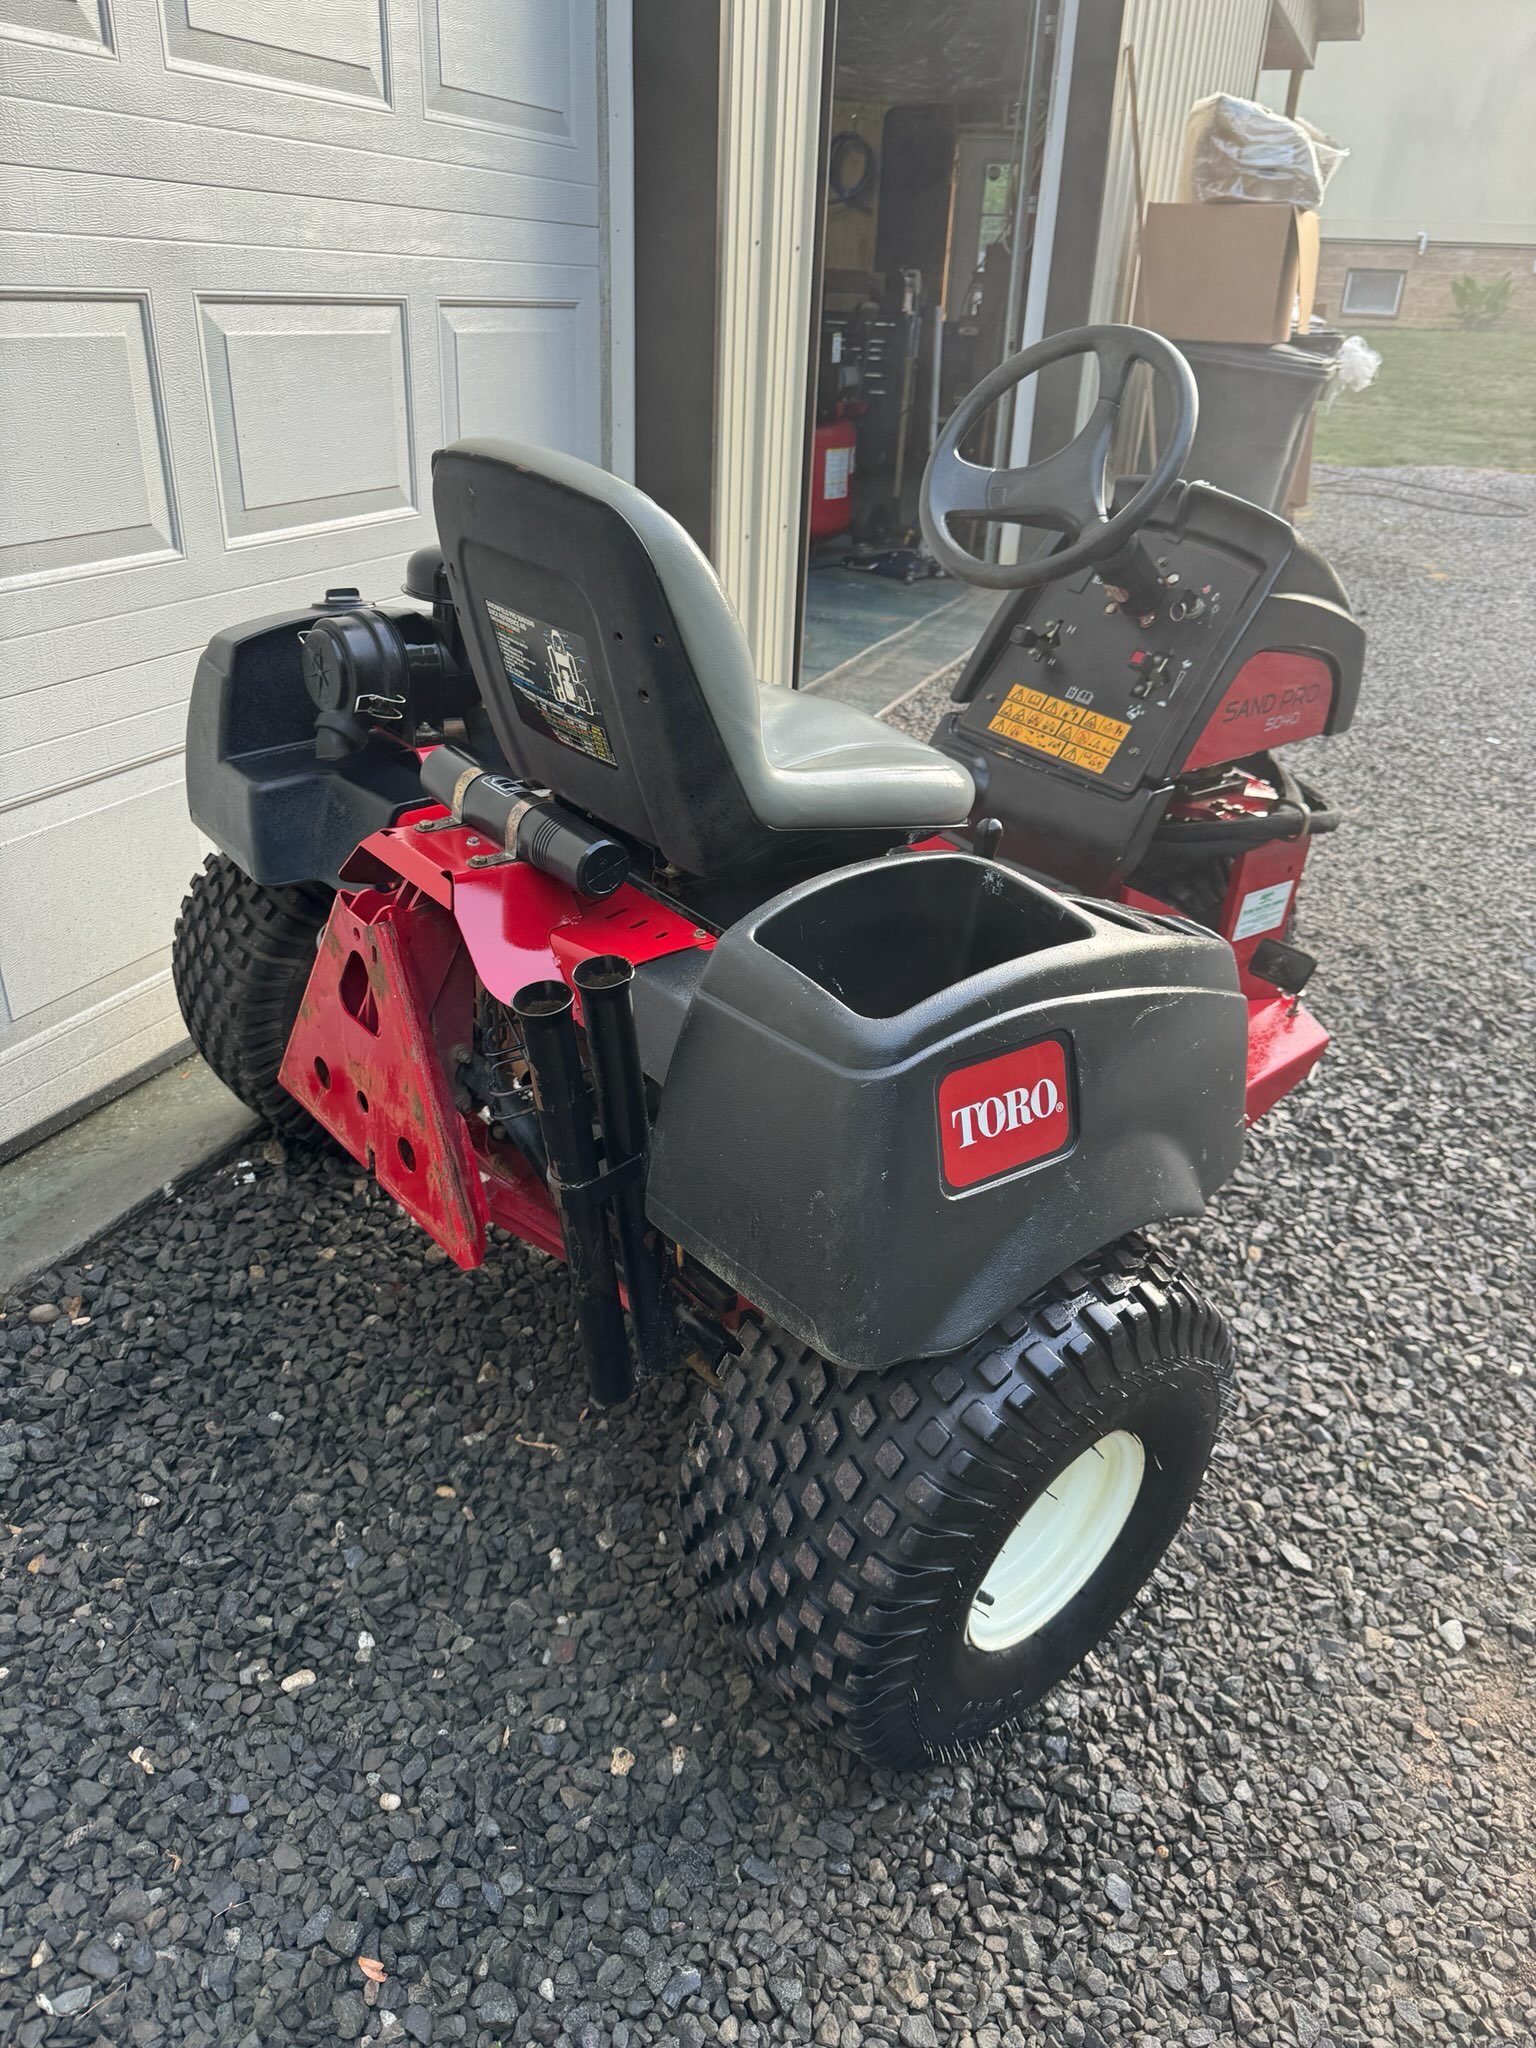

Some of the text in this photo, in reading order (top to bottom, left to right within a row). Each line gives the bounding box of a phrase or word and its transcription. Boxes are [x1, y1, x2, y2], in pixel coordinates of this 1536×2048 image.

[1222, 683, 1320, 723] SAND PRO
[1264, 711, 1300, 733] 5040
